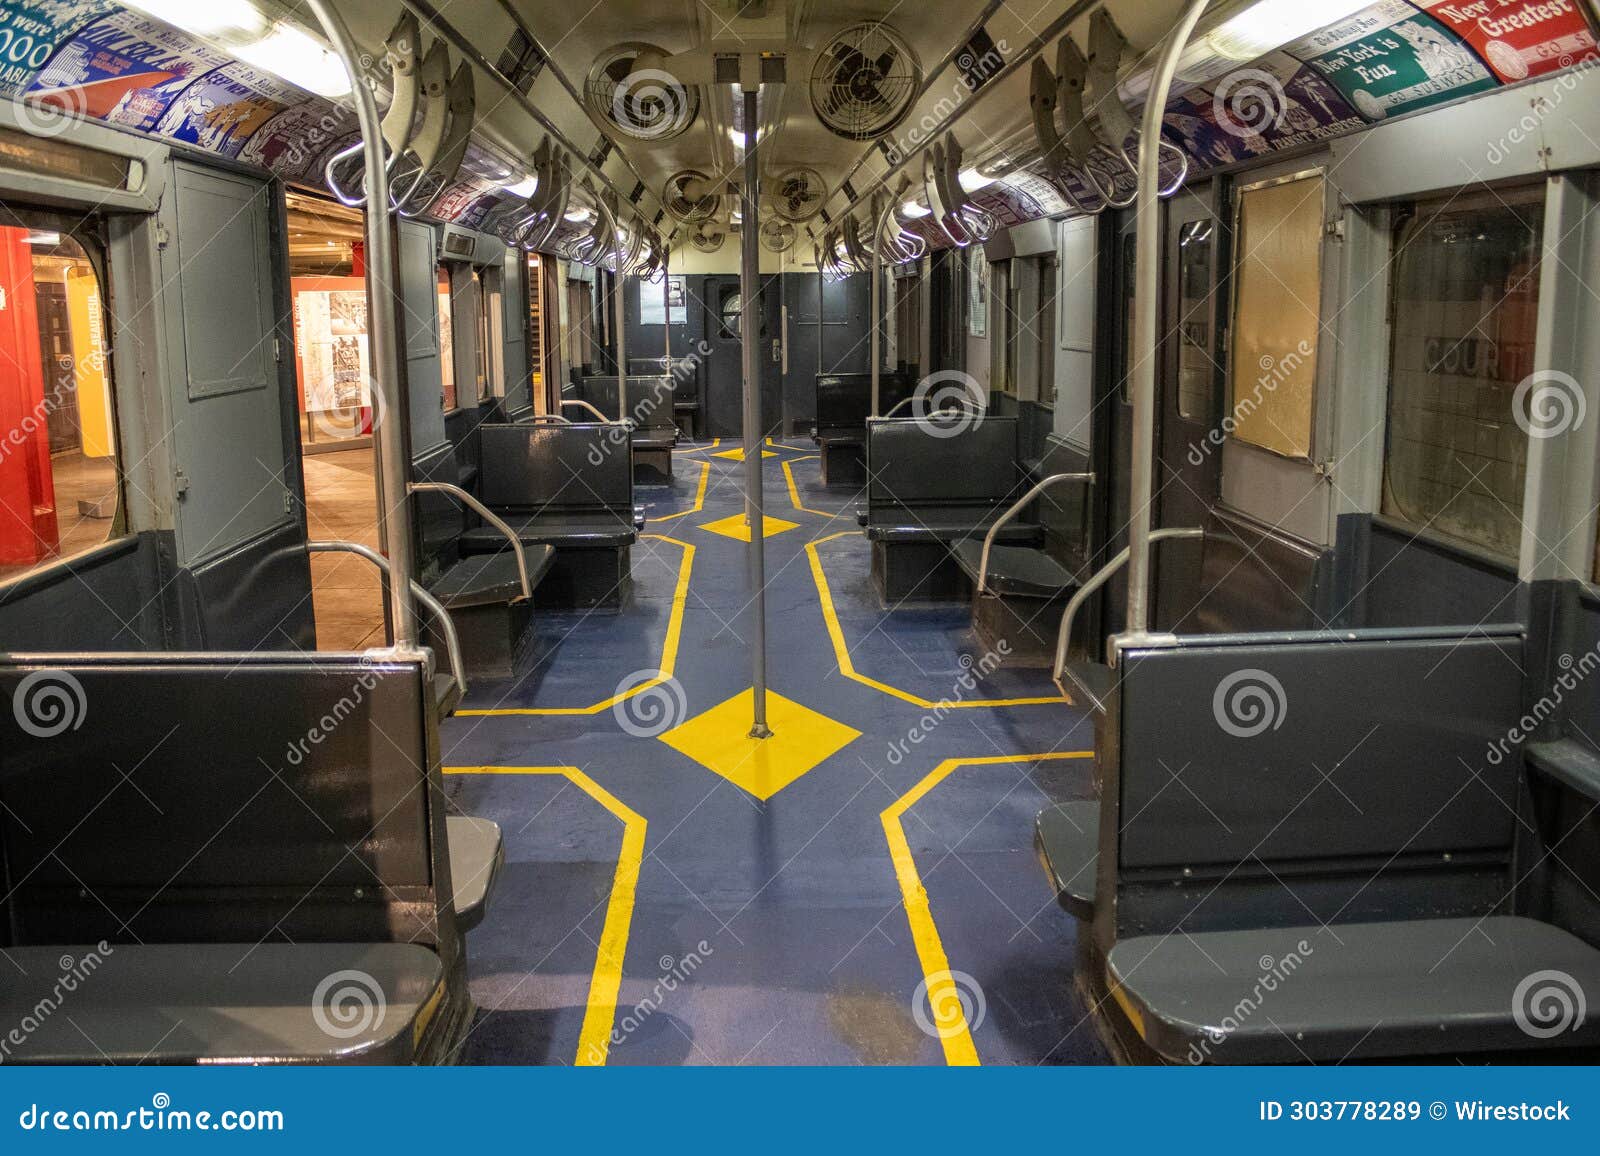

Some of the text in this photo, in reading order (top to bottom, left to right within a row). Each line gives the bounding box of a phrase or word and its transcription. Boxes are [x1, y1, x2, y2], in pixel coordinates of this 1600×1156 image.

[1438, 1, 1490, 24] New
[1478, 0, 1572, 37] Greatest
[12, 15, 52, 37] were
[114, 40, 168, 64] FOR
[1312, 38, 1400, 74] New York is
[1536, 42, 1562, 57] GO
[1353, 63, 1397, 84] Fun
[1387, 66, 1477, 104] GO SUBWAY
[88, 290, 102, 346] BEAUTIFUL
